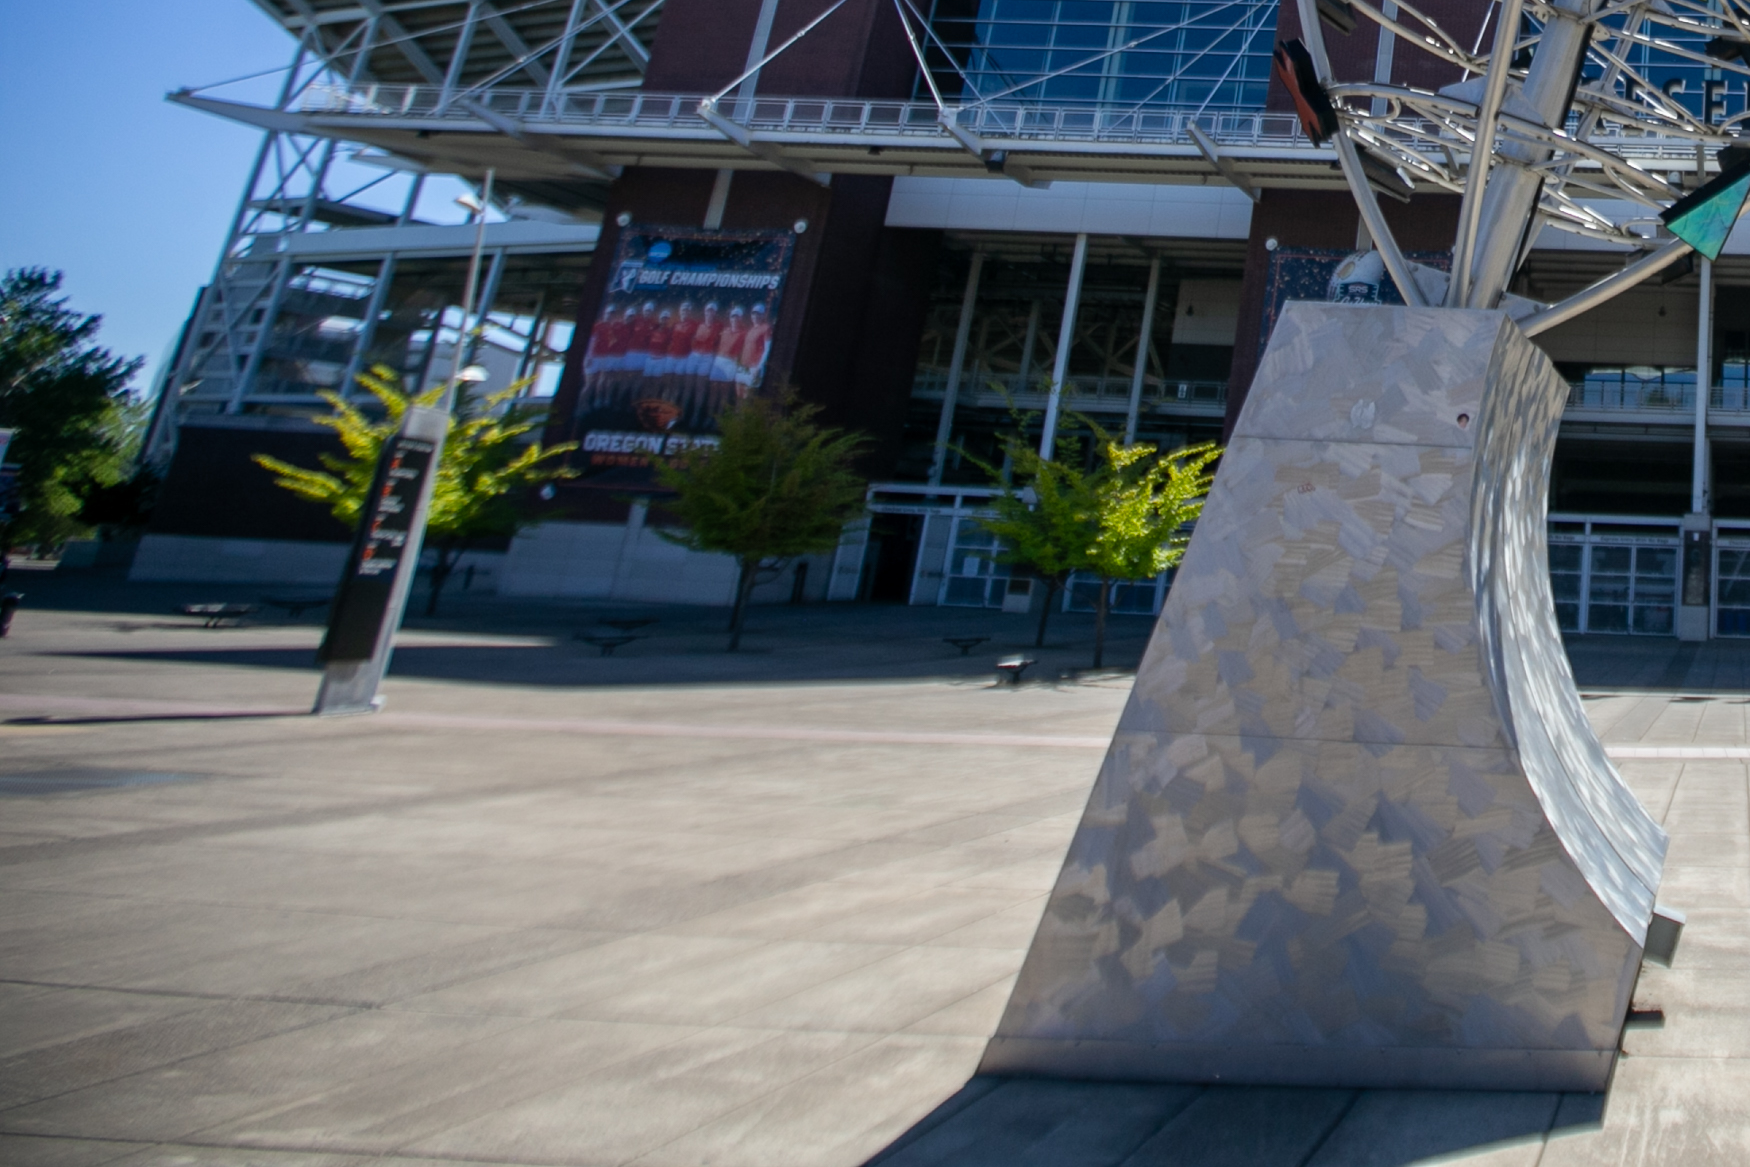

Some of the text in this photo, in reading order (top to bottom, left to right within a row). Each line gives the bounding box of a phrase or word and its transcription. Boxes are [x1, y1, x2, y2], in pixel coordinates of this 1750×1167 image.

[638, 271, 781, 290] GOLF CHAMPIONSHIPS
[1348, 285, 1369, 294] SRS
[583, 434, 663, 454] OREGON
